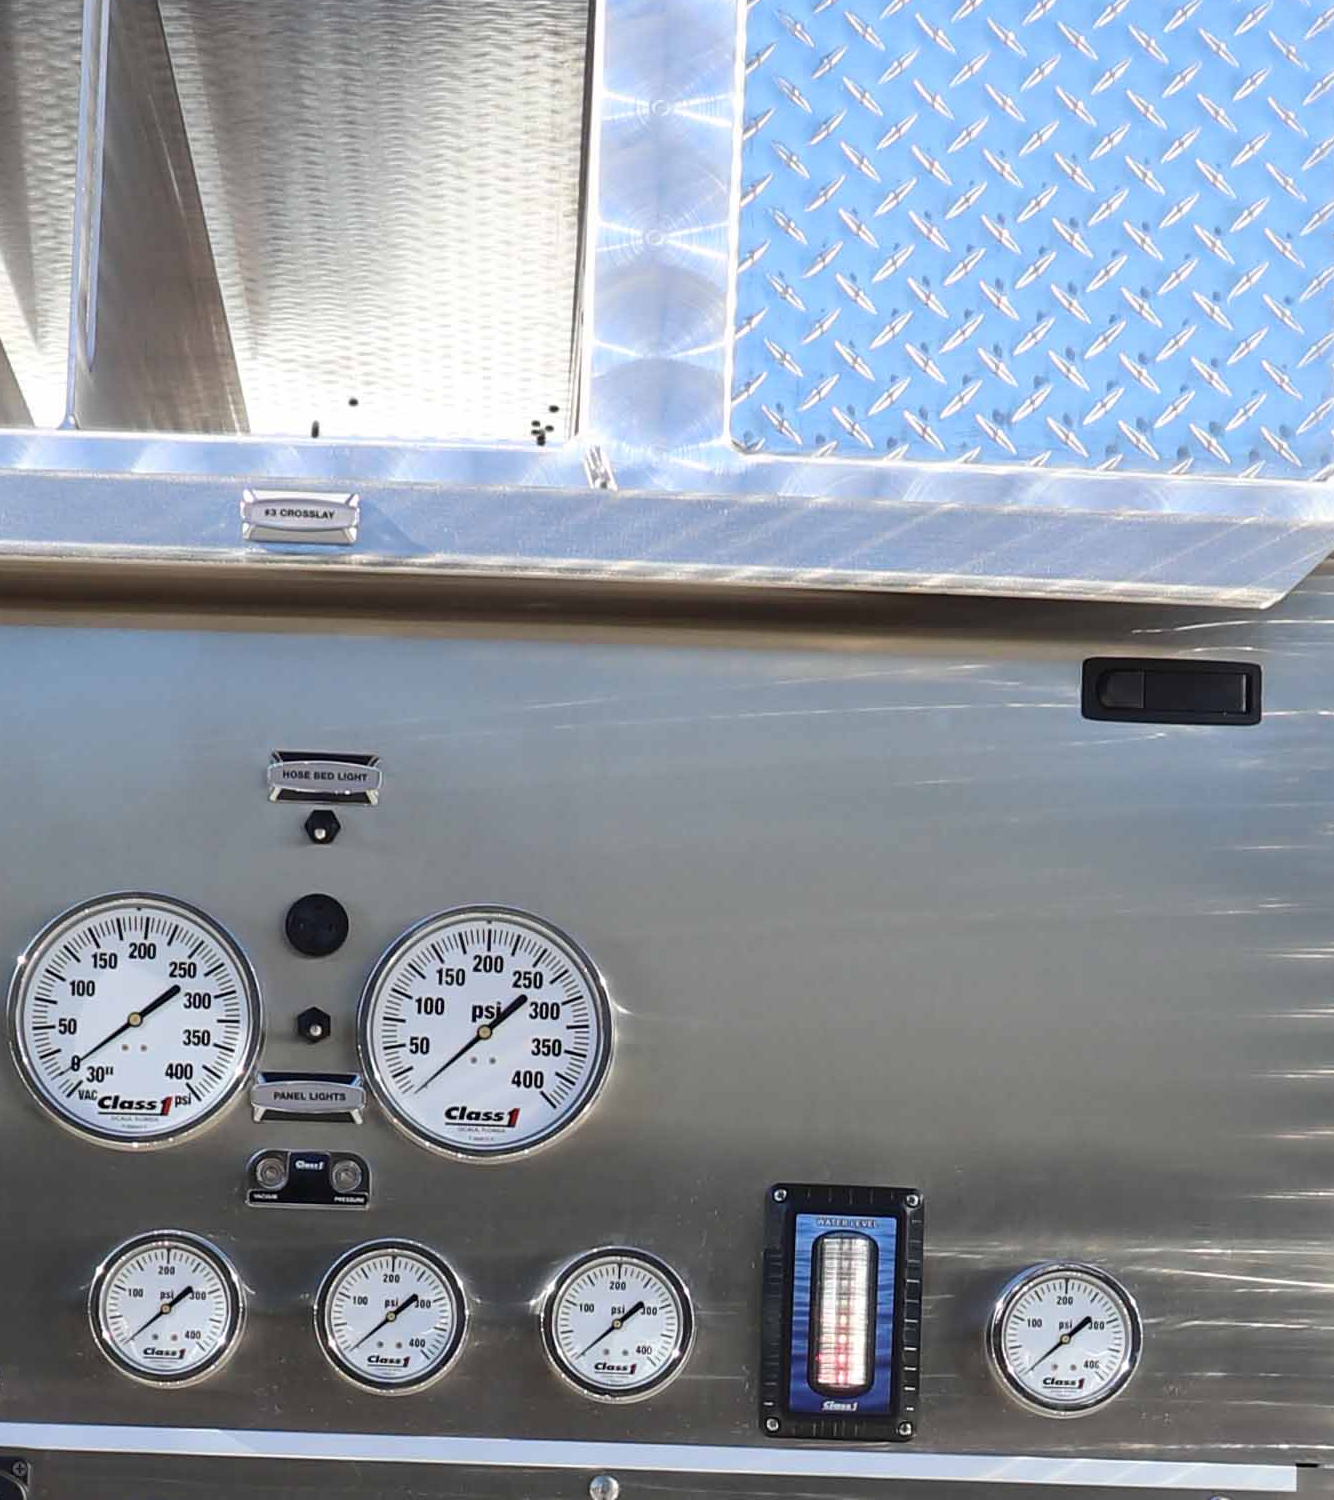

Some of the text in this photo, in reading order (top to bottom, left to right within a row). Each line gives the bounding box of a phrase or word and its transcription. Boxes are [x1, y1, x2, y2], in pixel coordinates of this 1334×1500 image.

[265, 508, 335, 520] #3 CROSSLAY
[282, 770, 367, 782] HOSE BED LIGHT
[129, 942, 157, 960] 200
[92, 952, 118, 970] 150
[473, 955, 504, 973] 200
[169, 961, 197, 979] 250
[436, 968, 465, 986] 150
[512, 970, 543, 989] 250
[69, 980, 96, 997] 100
[183, 992, 212, 1010] 300
[415, 997, 445, 1015] 100
[471, 1002, 502, 1023] psi
[529, 1002, 560, 1020] 300
[58, 1018, 77, 1035] 50
[182, 1029, 211, 1047] 350
[409, 1037, 430, 1055] 50
[531, 1038, 562, 1057] 350
[70, 1055, 81, 1072] 0
[165, 1063, 194, 1080] 400
[86, 1066, 114, 1083] 30"
[511, 1071, 544, 1089] 400
[78, 1089, 98, 1101] VAC
[174, 1093, 192, 1107] psi
[273, 1091, 347, 1101] PANEL LIGHTS
[97, 1095, 172, 1116] Class1
[444, 1106, 520, 1127] Class1
[158, 1266, 175, 1275] 200
[128, 1288, 144, 1298] 100
[1056, 1296, 1073, 1306] 200
[1027, 1318, 1042, 1328] 100
[143, 1348, 186, 1360] Class1
[367, 1355, 411, 1368] Class1
[594, 1362, 637, 1375] Class1
[1043, 1377, 1085, 1390] Class1
